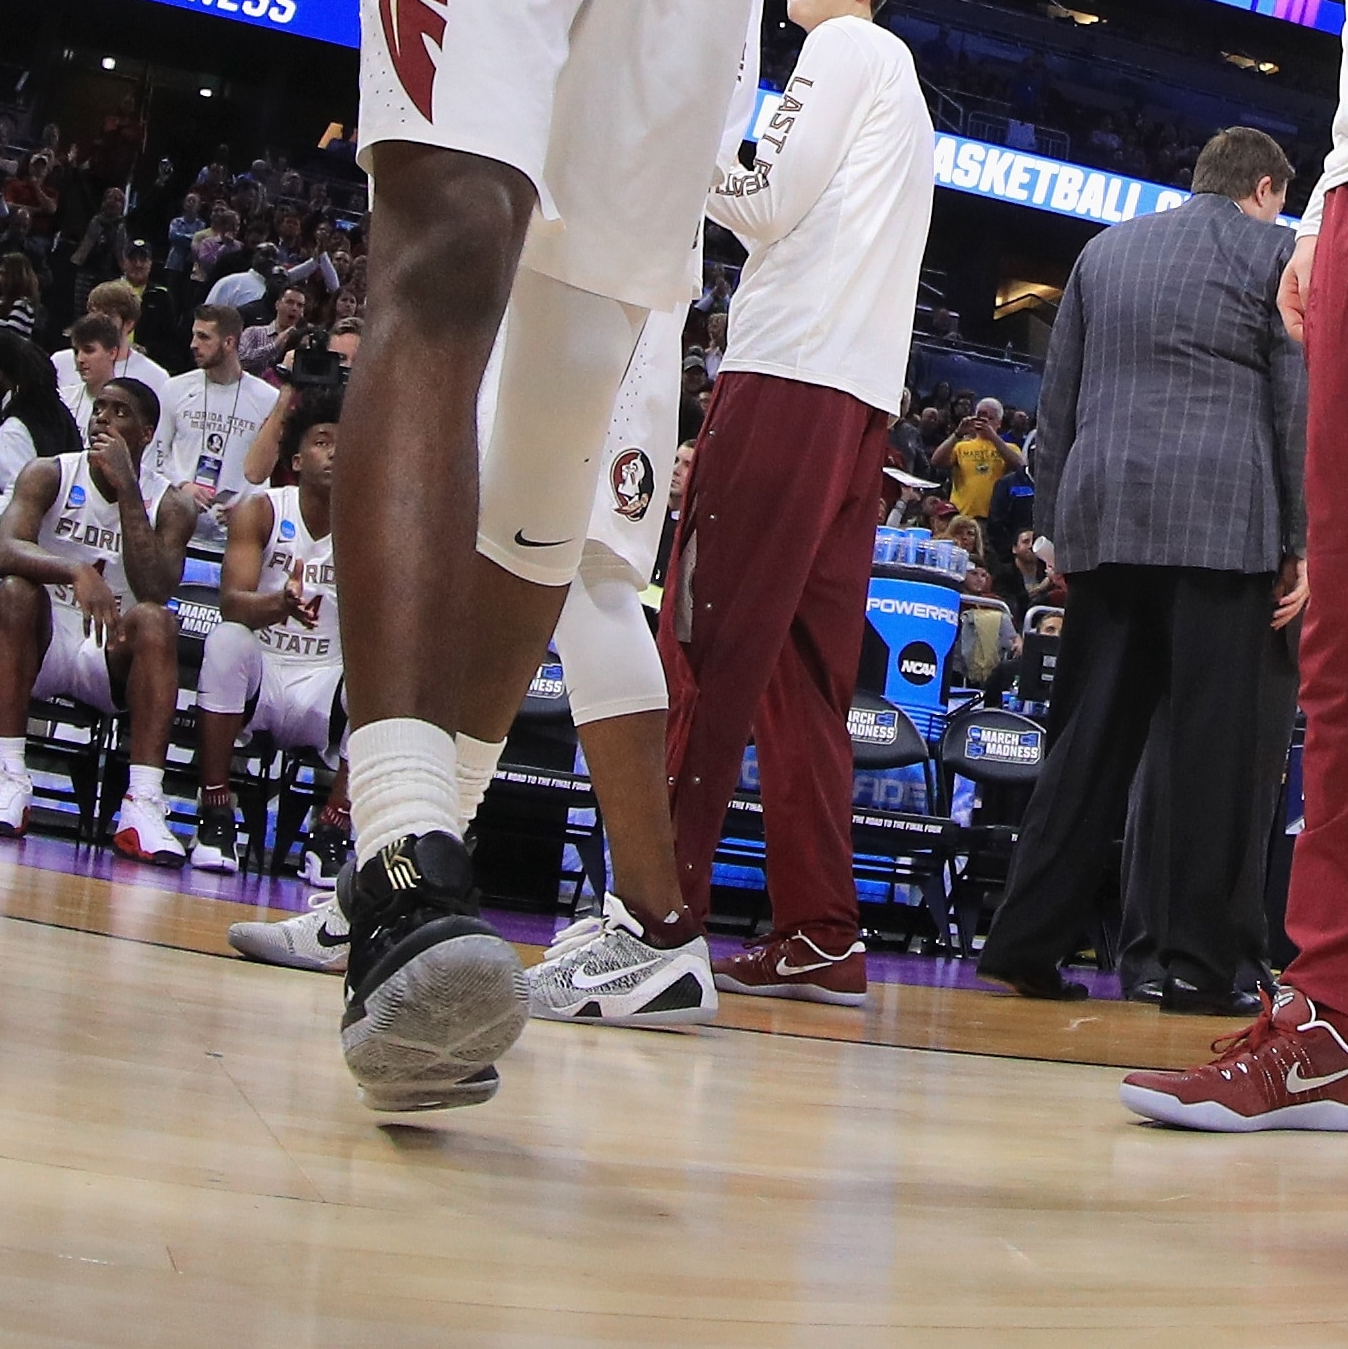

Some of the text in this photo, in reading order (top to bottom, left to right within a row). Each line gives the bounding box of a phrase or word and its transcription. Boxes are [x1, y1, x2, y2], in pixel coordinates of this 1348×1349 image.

[761, 76, 815, 154] LAST
[259, 626, 331, 655] STATE
[900, 659, 937, 678] NCAA
[980, 730, 1020, 746] MARCH
[985, 743, 1039, 759] MADNESS
